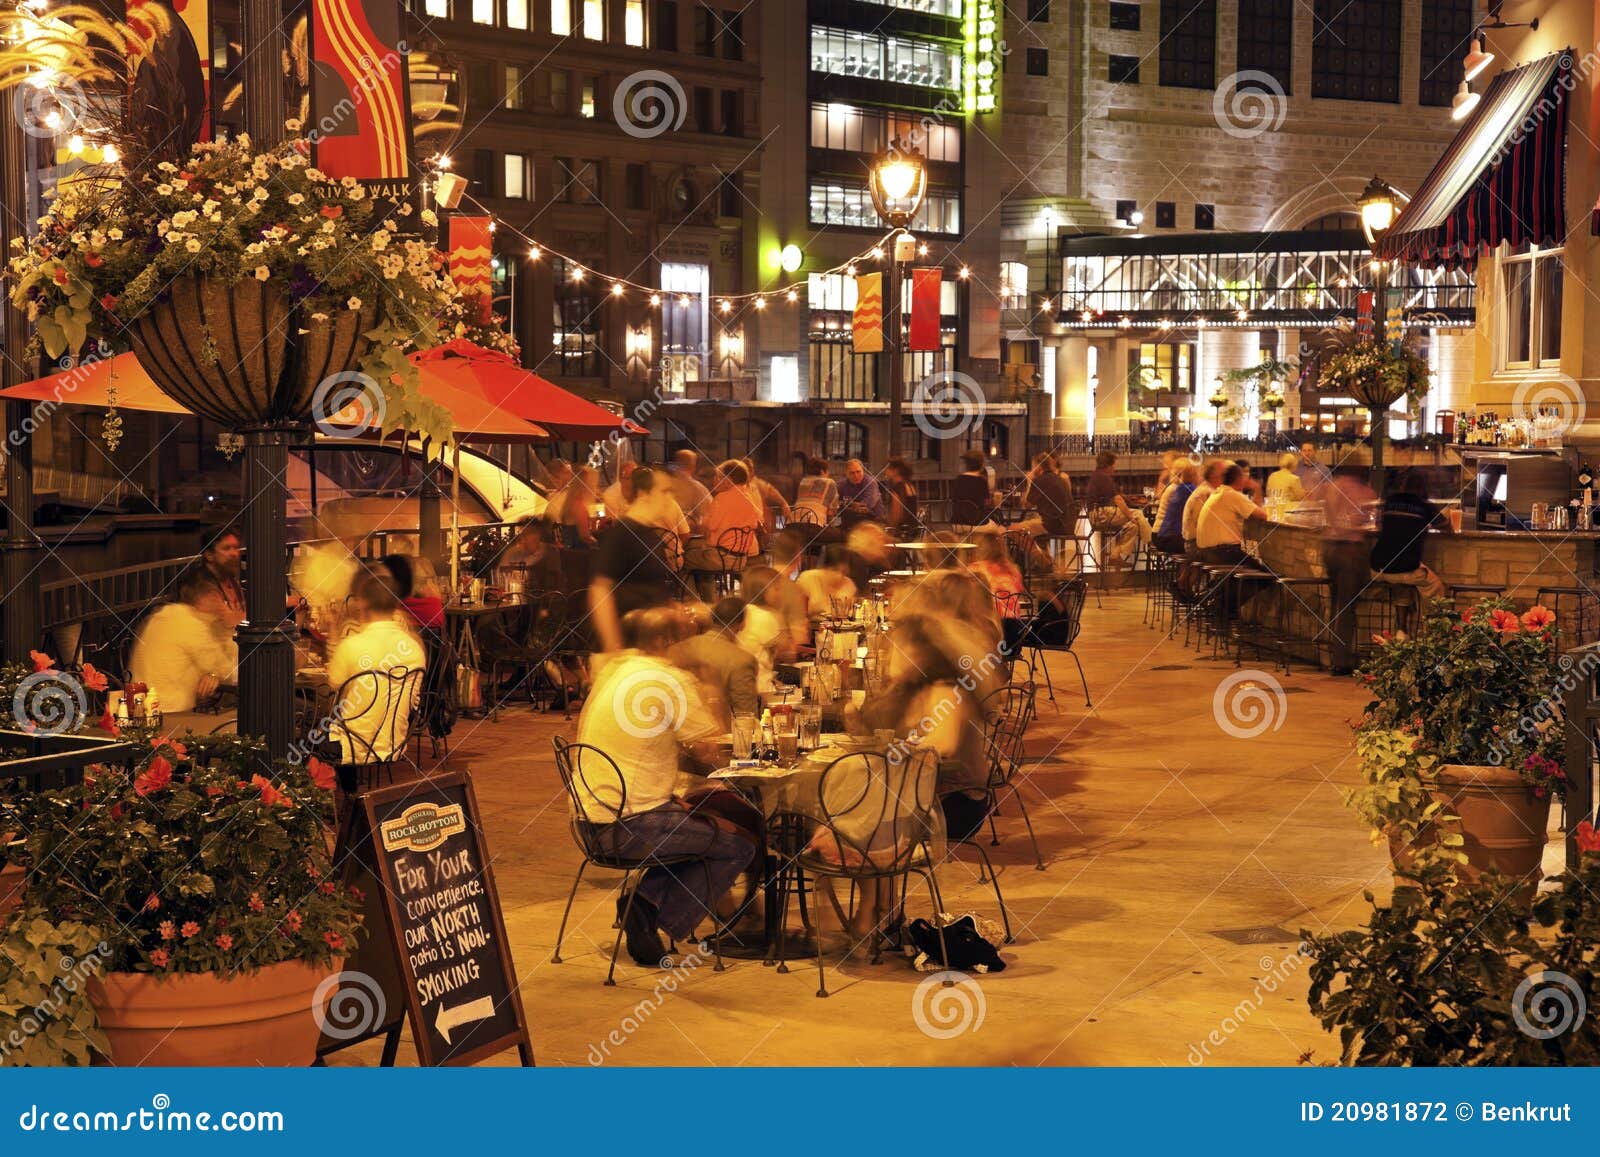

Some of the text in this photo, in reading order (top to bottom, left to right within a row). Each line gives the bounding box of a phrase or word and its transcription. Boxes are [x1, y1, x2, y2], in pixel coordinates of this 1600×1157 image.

[406, 879, 484, 920] convenience,
[405, 902, 481, 949] OUR NORTH
[410, 945, 438, 977] patio
[439, 940, 455, 960] is
[416, 958, 480, 1006] SMOKING
